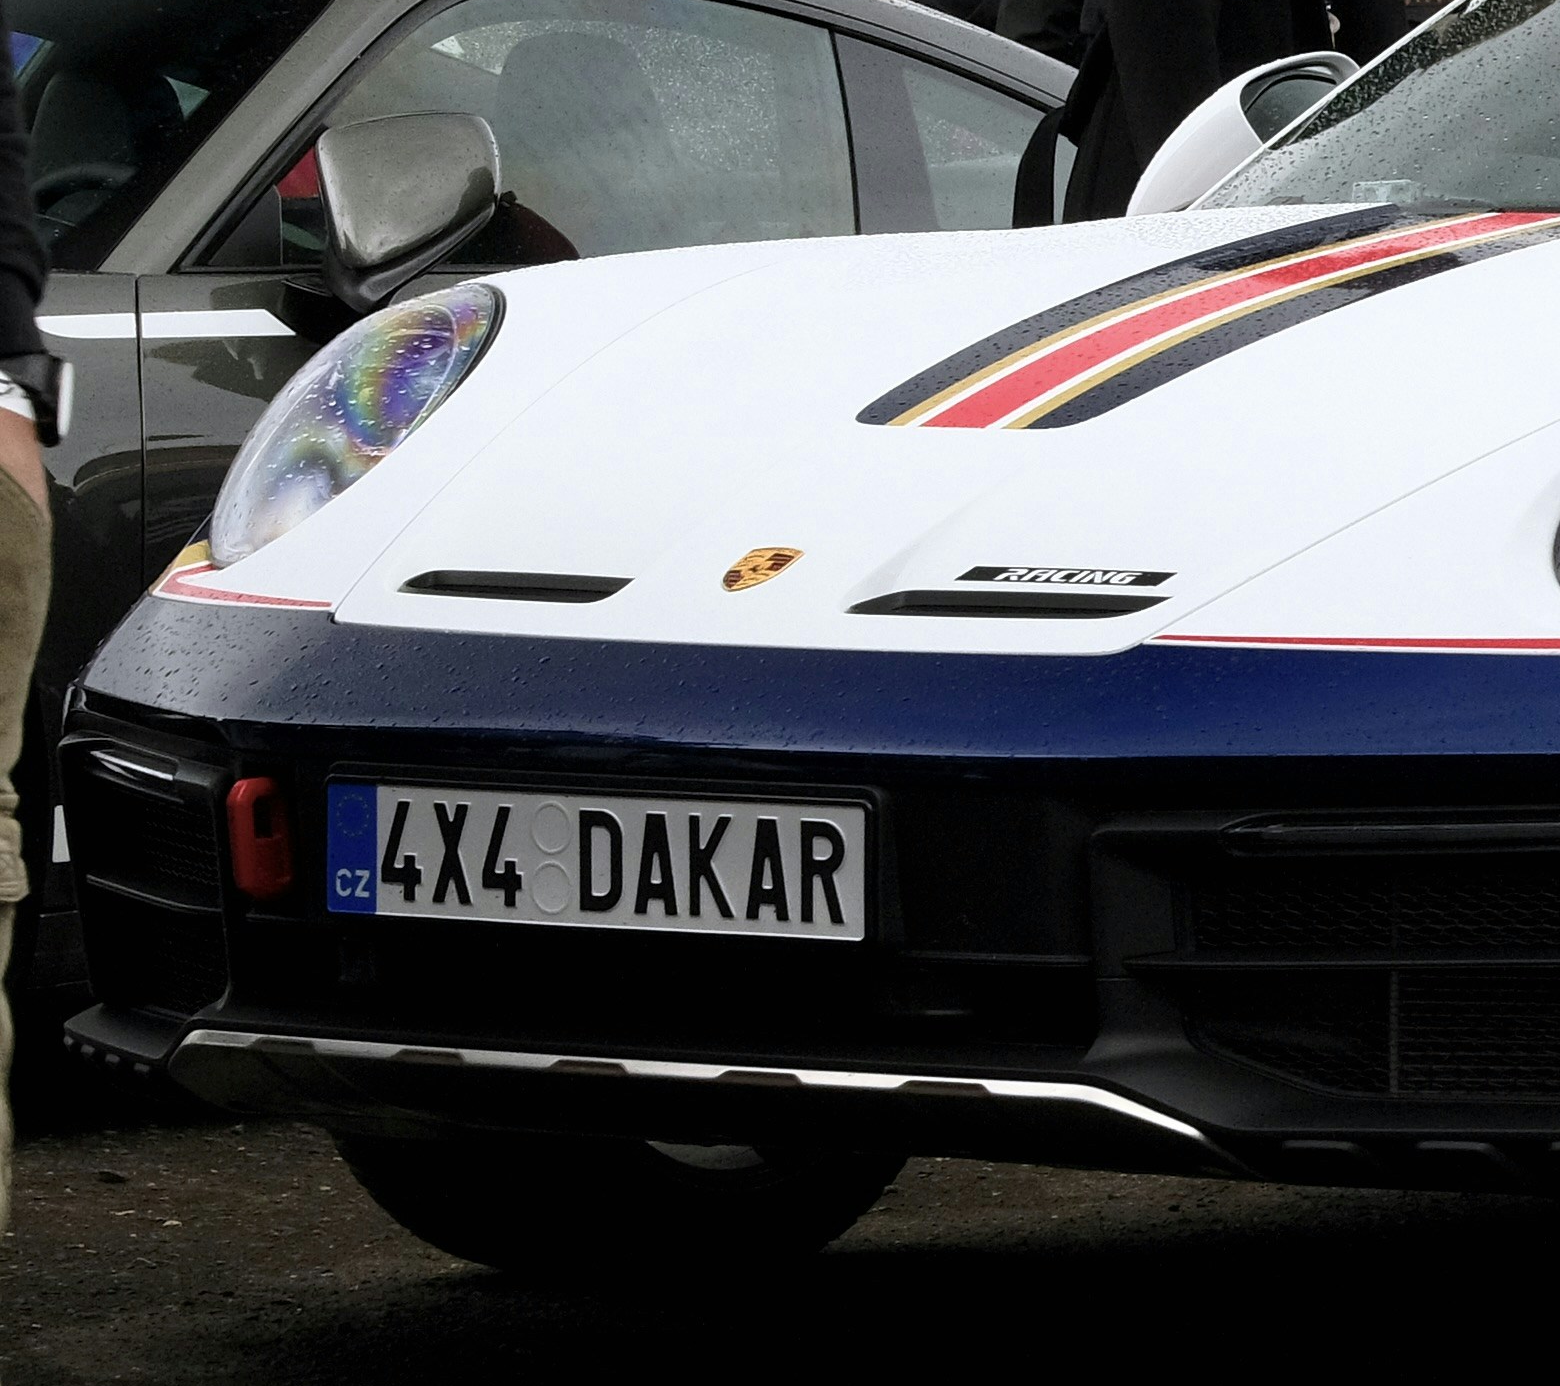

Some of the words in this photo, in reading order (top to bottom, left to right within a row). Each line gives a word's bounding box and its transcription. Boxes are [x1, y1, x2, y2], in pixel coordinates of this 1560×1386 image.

[993, 568, 1142, 585] RACING
[381, 798, 523, 907] 4X4
[578, 807, 846, 925] DAKAR
[335, 867, 371, 899] CZ
